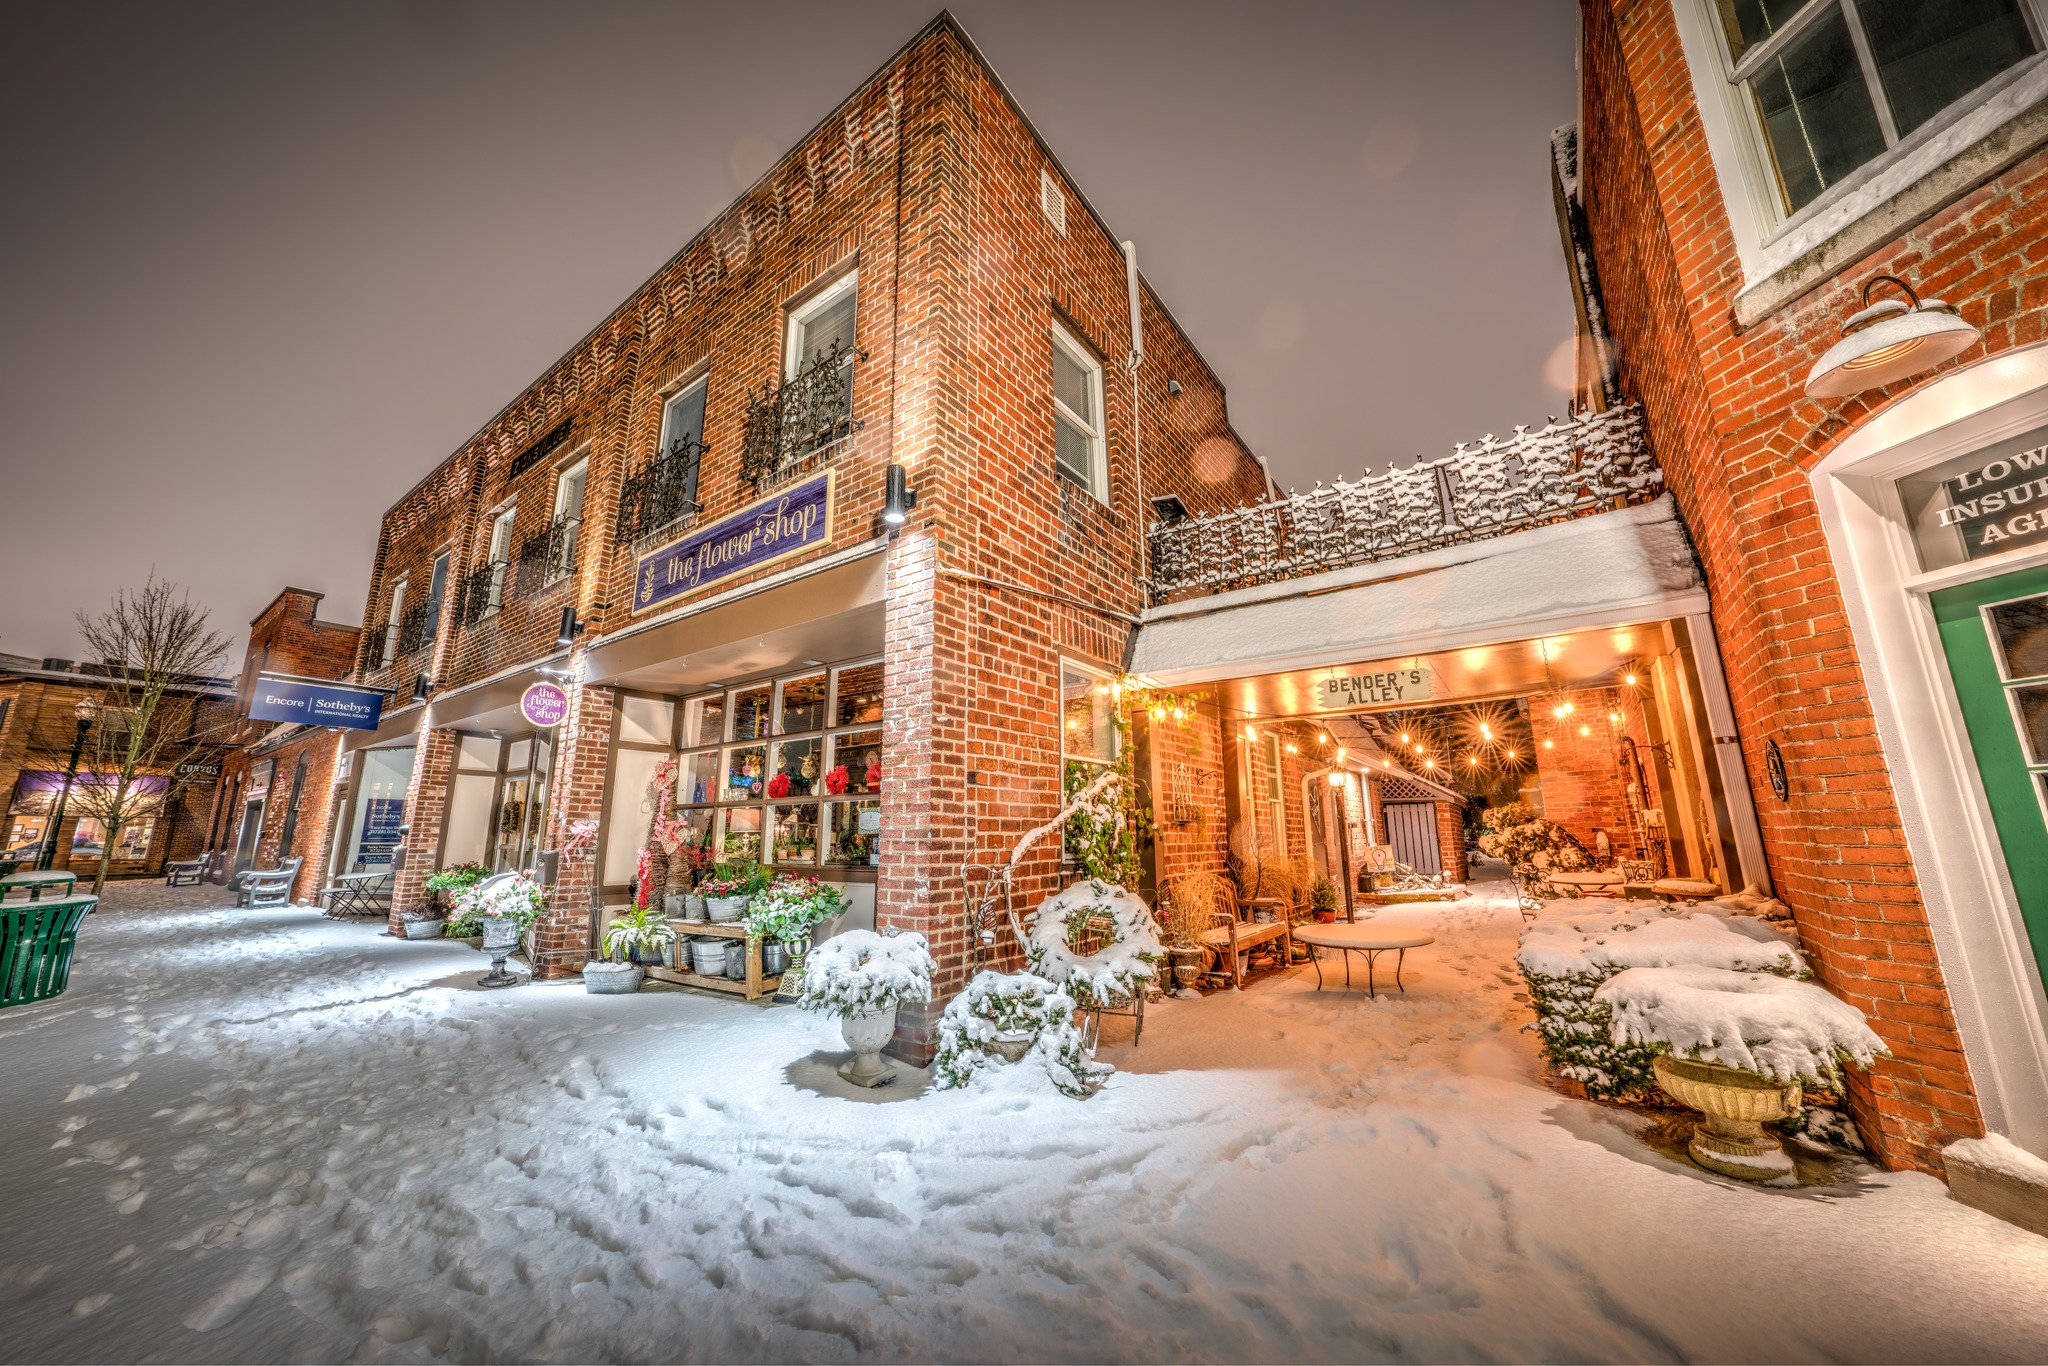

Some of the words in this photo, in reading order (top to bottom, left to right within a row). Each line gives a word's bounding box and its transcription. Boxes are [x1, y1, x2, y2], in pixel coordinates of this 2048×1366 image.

[667, 556, 693, 585] the
[690, 525, 760, 587] flower
[757, 496, 817, 546] shop
[1328, 670, 1421, 694] BENDER'S
[526, 694, 565, 708] flower
[539, 687, 556, 699] the
[1347, 685, 1404, 706] ALLEY
[265, 695, 305, 708] Encore
[315, 698, 371, 714] Sotheby's
[314, 709, 352, 718] INTERNATIONAL
[532, 706, 561, 723] shop
